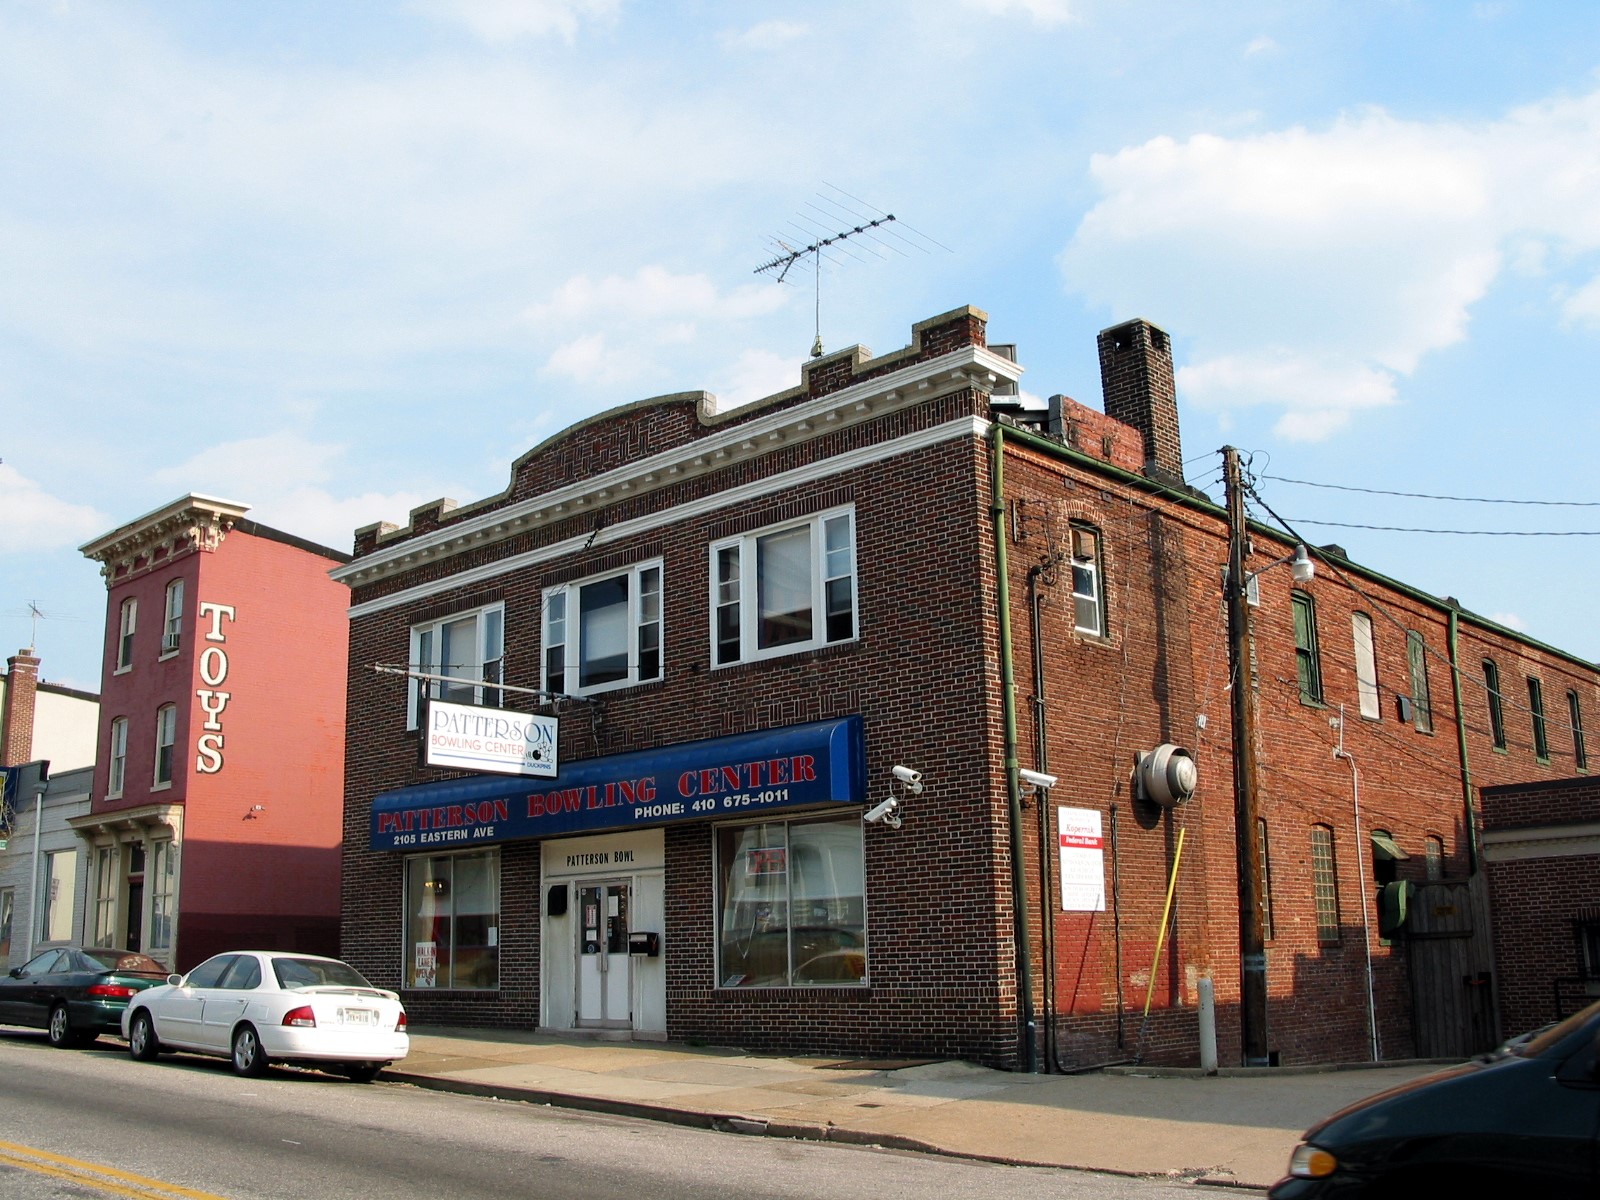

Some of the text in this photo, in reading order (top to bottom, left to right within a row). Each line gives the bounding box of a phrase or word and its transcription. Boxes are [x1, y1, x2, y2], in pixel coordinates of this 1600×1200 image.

[196, 601, 236, 774] TOYS
[433, 710, 554, 744] PATTERSON
[431, 734, 524, 755] BOWLING CENTER
[526, 761, 552, 770] DUCKPINS
[377, 754, 817, 834] PATTERSON BOWLING CENTER
[634, 788, 789, 819] PHONE: 410 675-1011
[393, 826, 494, 846] 2105 EASTERN AVE
[1085, 838, 1098, 846] Bank
[566, 850, 635, 867] PATTERSON BOWL
